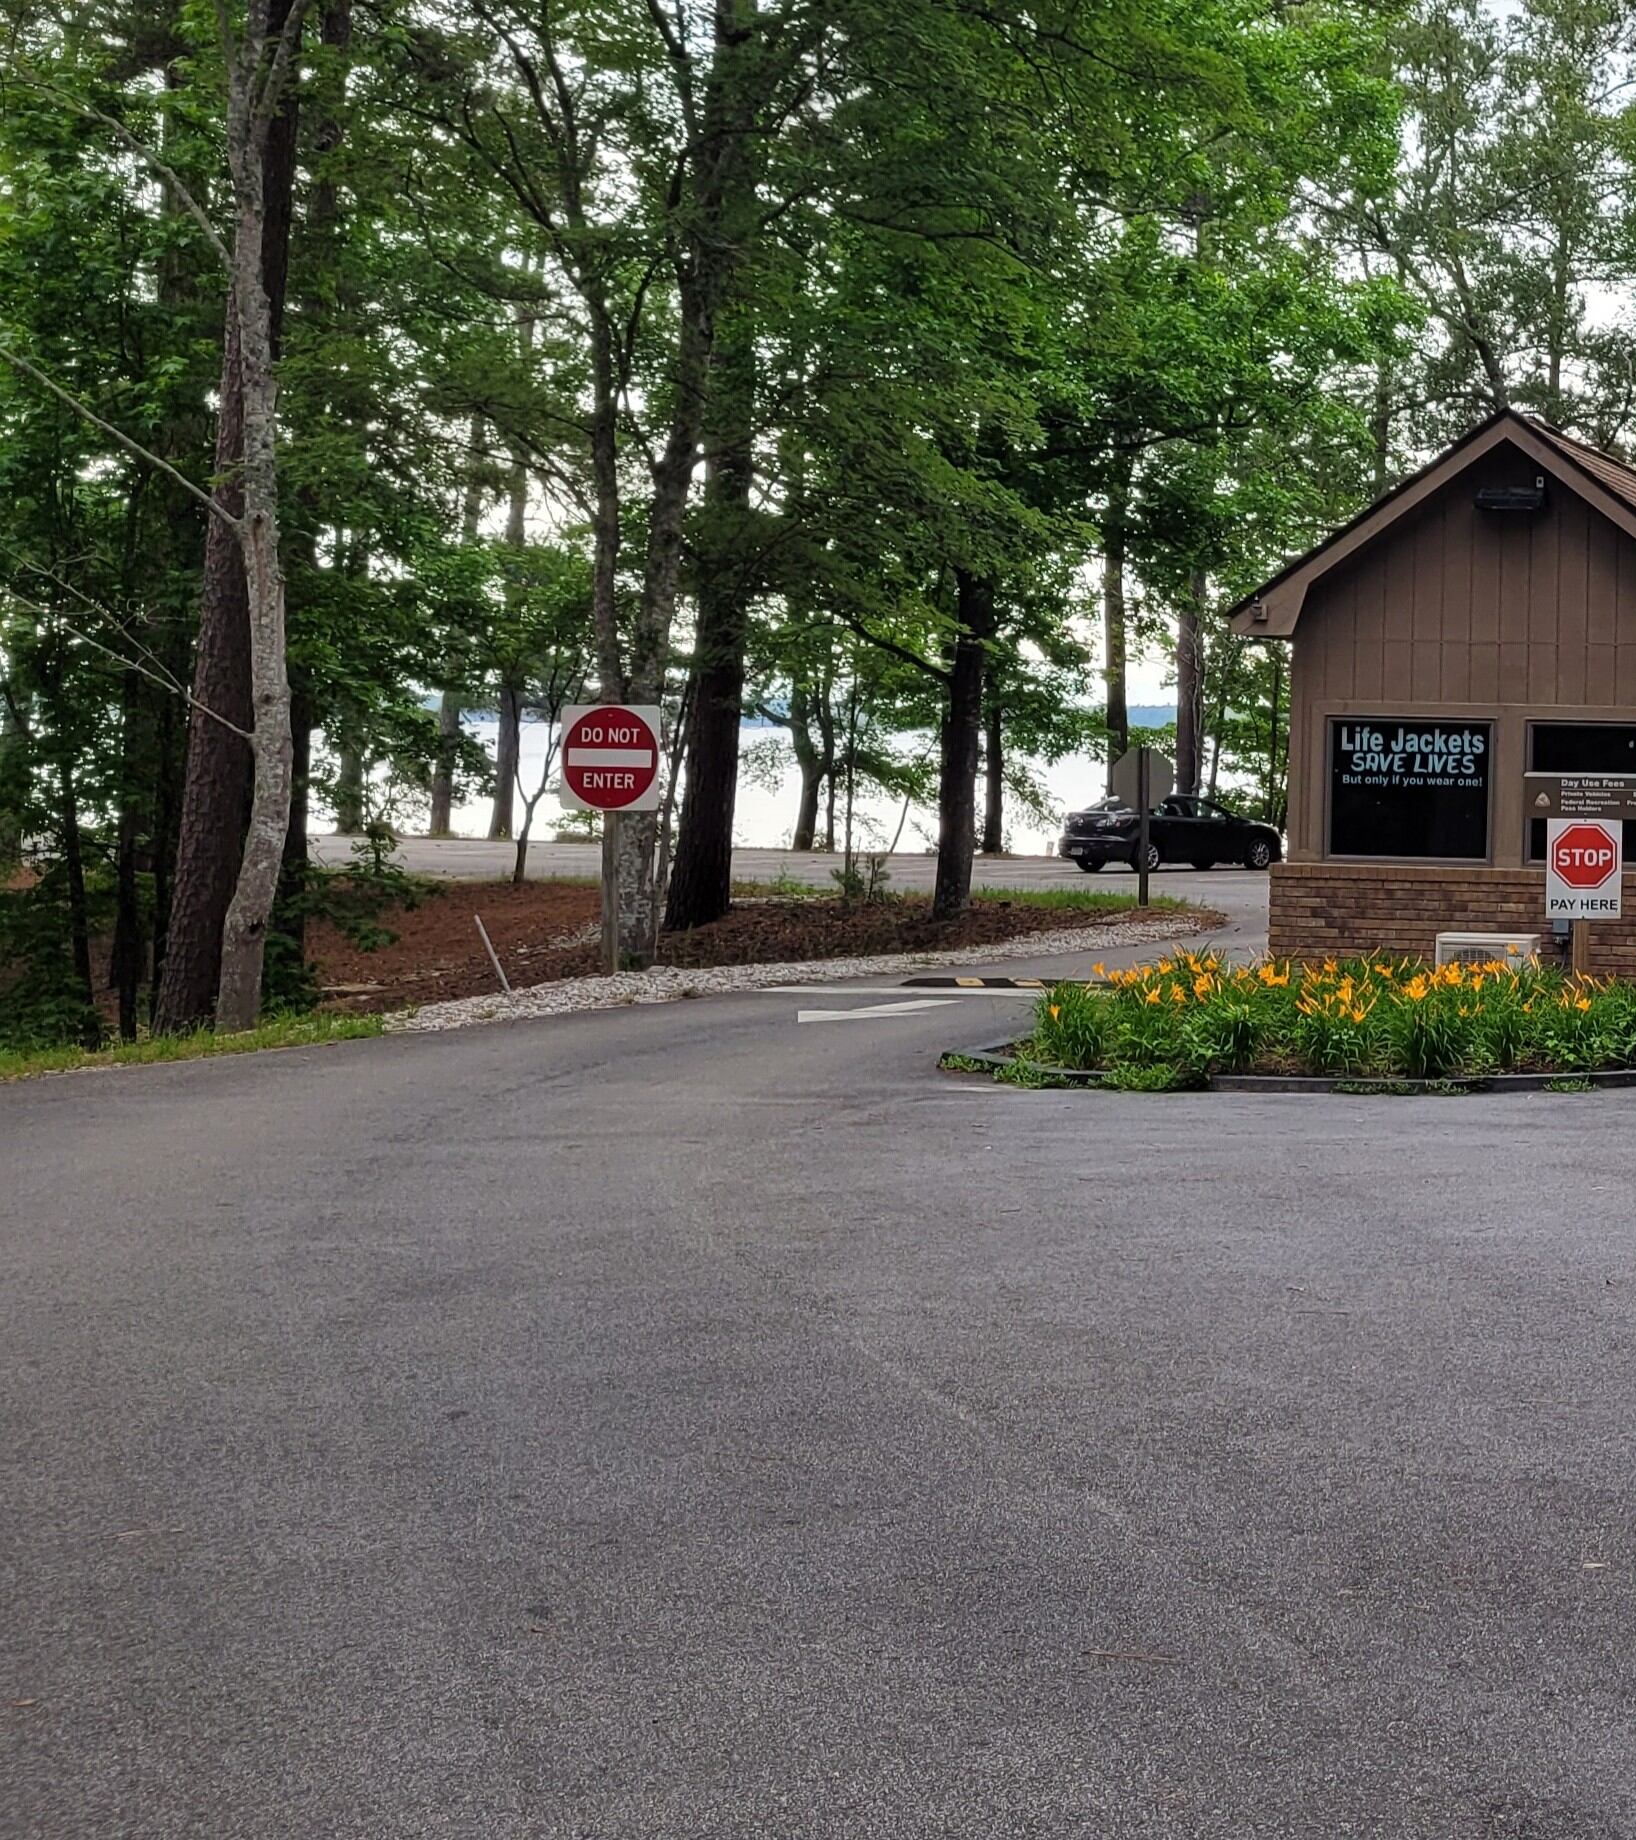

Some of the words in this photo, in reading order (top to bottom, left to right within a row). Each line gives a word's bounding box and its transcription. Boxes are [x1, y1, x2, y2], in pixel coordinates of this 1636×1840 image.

[581, 727, 603, 743] DO
[608, 728, 641, 744] NOT
[1341, 726, 1384, 752] Life
[1391, 727, 1485, 754] Jackets
[1350, 752, 1407, 772] SAVE
[1413, 753, 1475, 774] LIVES
[583, 772, 635, 789] ENTER
[1342, 774, 1362, 785] But
[1365, 775, 1389, 788] only
[1392, 775, 1400, 785] if
[1403, 777, 1423, 788] you
[1427, 777, 1455, 787] wear
[1458, 777, 1483, 787] one!
[1561, 779, 1579, 789] Day
[1582, 779, 1600, 788] Use
[1603, 780, 1625, 788] Fees
[1558, 848, 1612, 867] STOP
[1550, 899, 1577, 911] PAY
[1580, 899, 1618, 911] HERE
